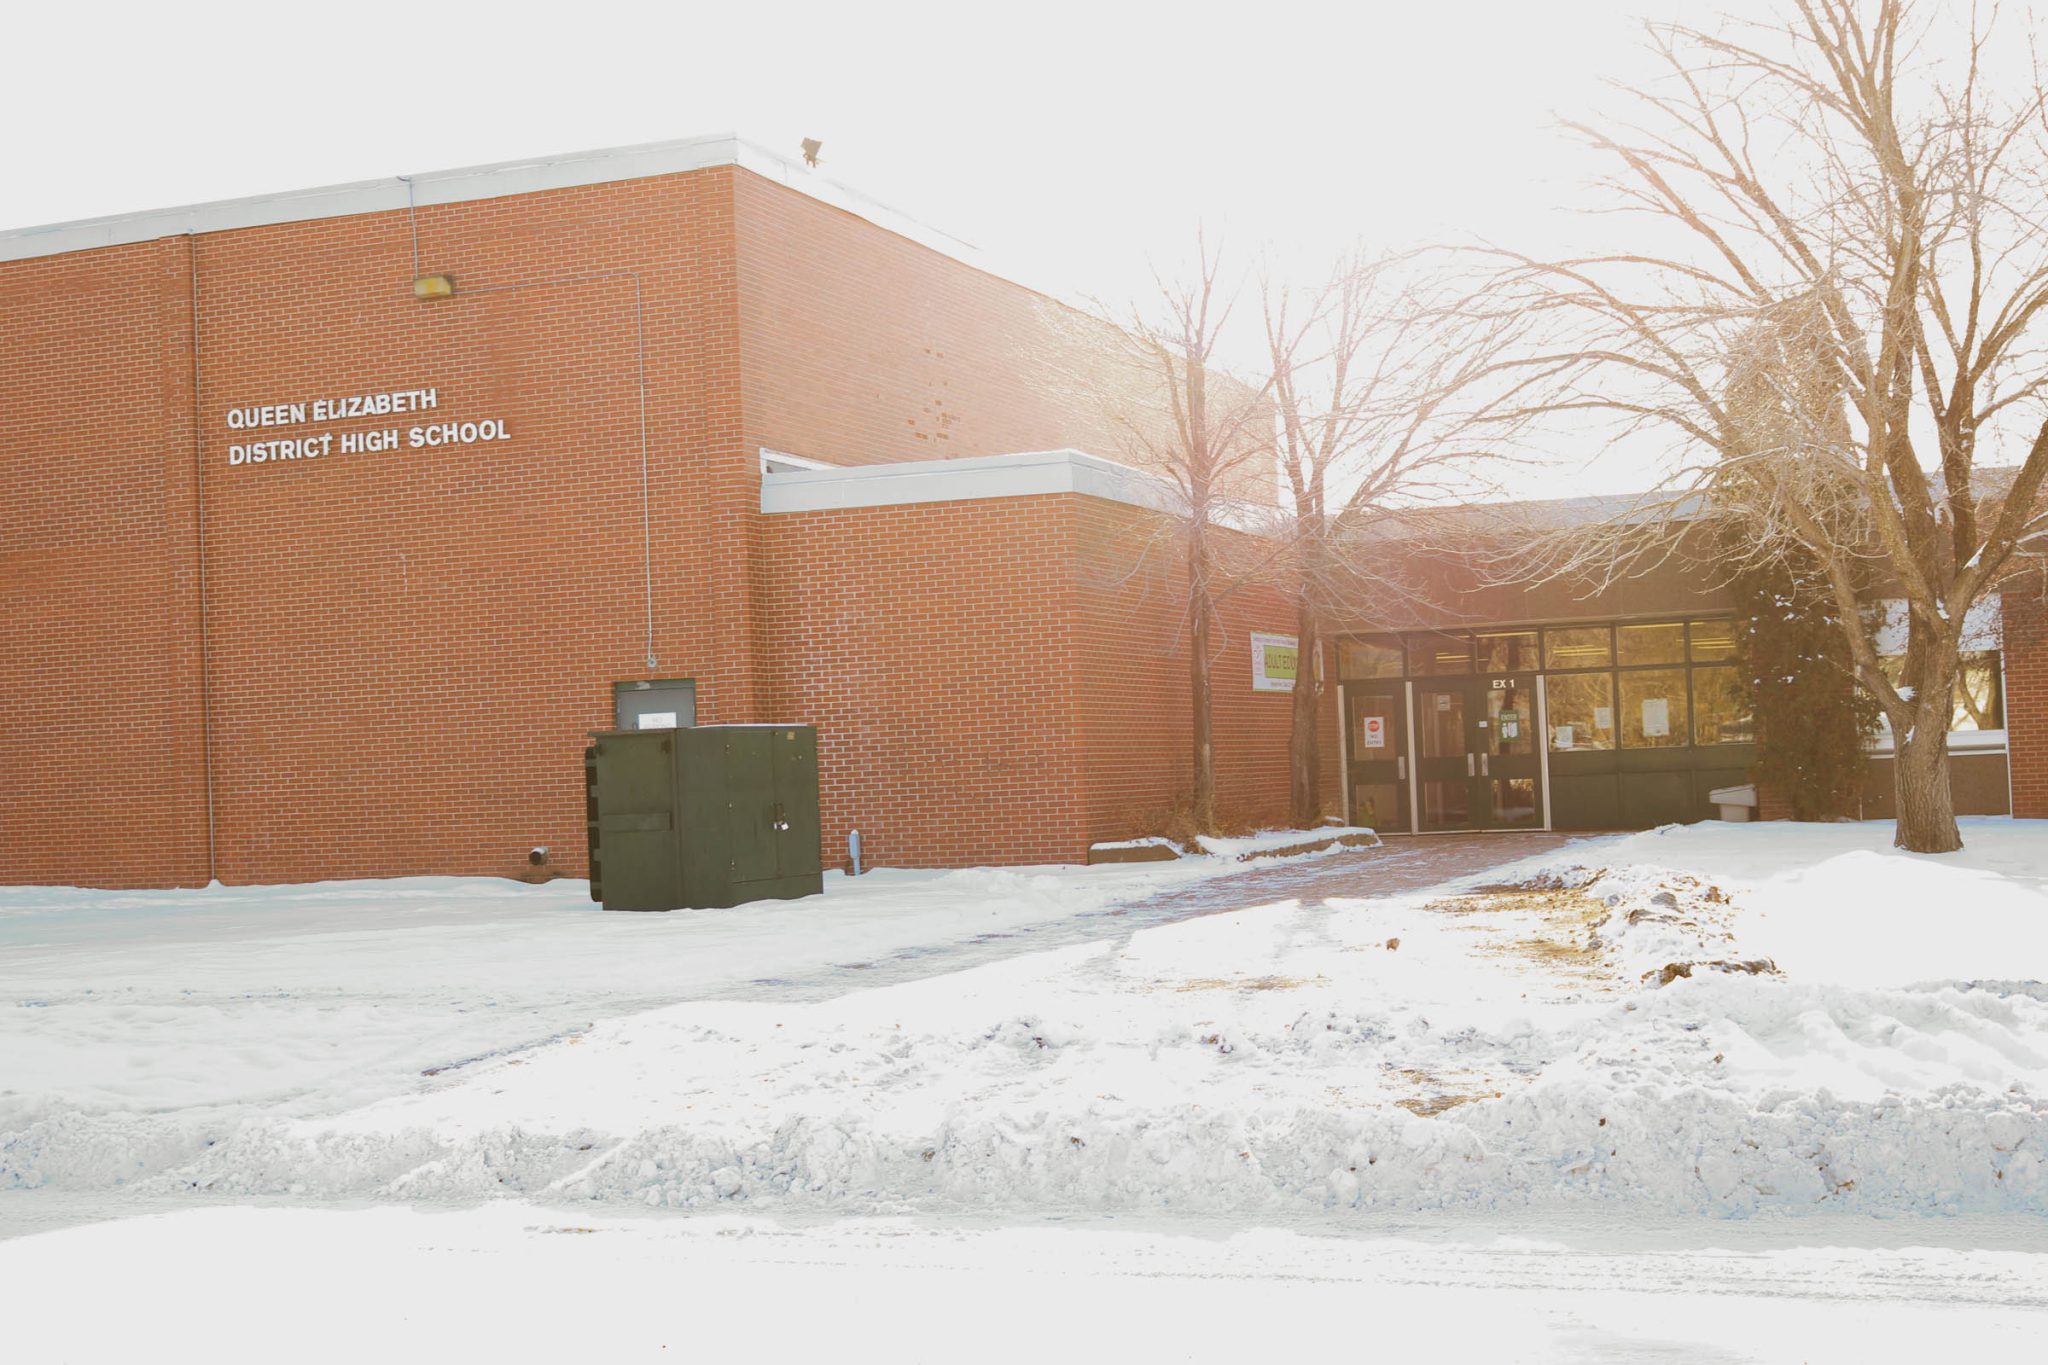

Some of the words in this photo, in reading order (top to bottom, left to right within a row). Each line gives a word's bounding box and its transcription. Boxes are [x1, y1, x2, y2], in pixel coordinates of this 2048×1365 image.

[227, 403, 306, 429] QUEEN
[313, 388, 437, 422] ELIZABETH
[229, 433, 333, 465] DISTRICT
[341, 429, 399, 454] HIGH
[409, 419, 511, 448] SCHOOL
[1492, 679, 1507, 689] EX
[1509, 678, 1515, 688] 1
